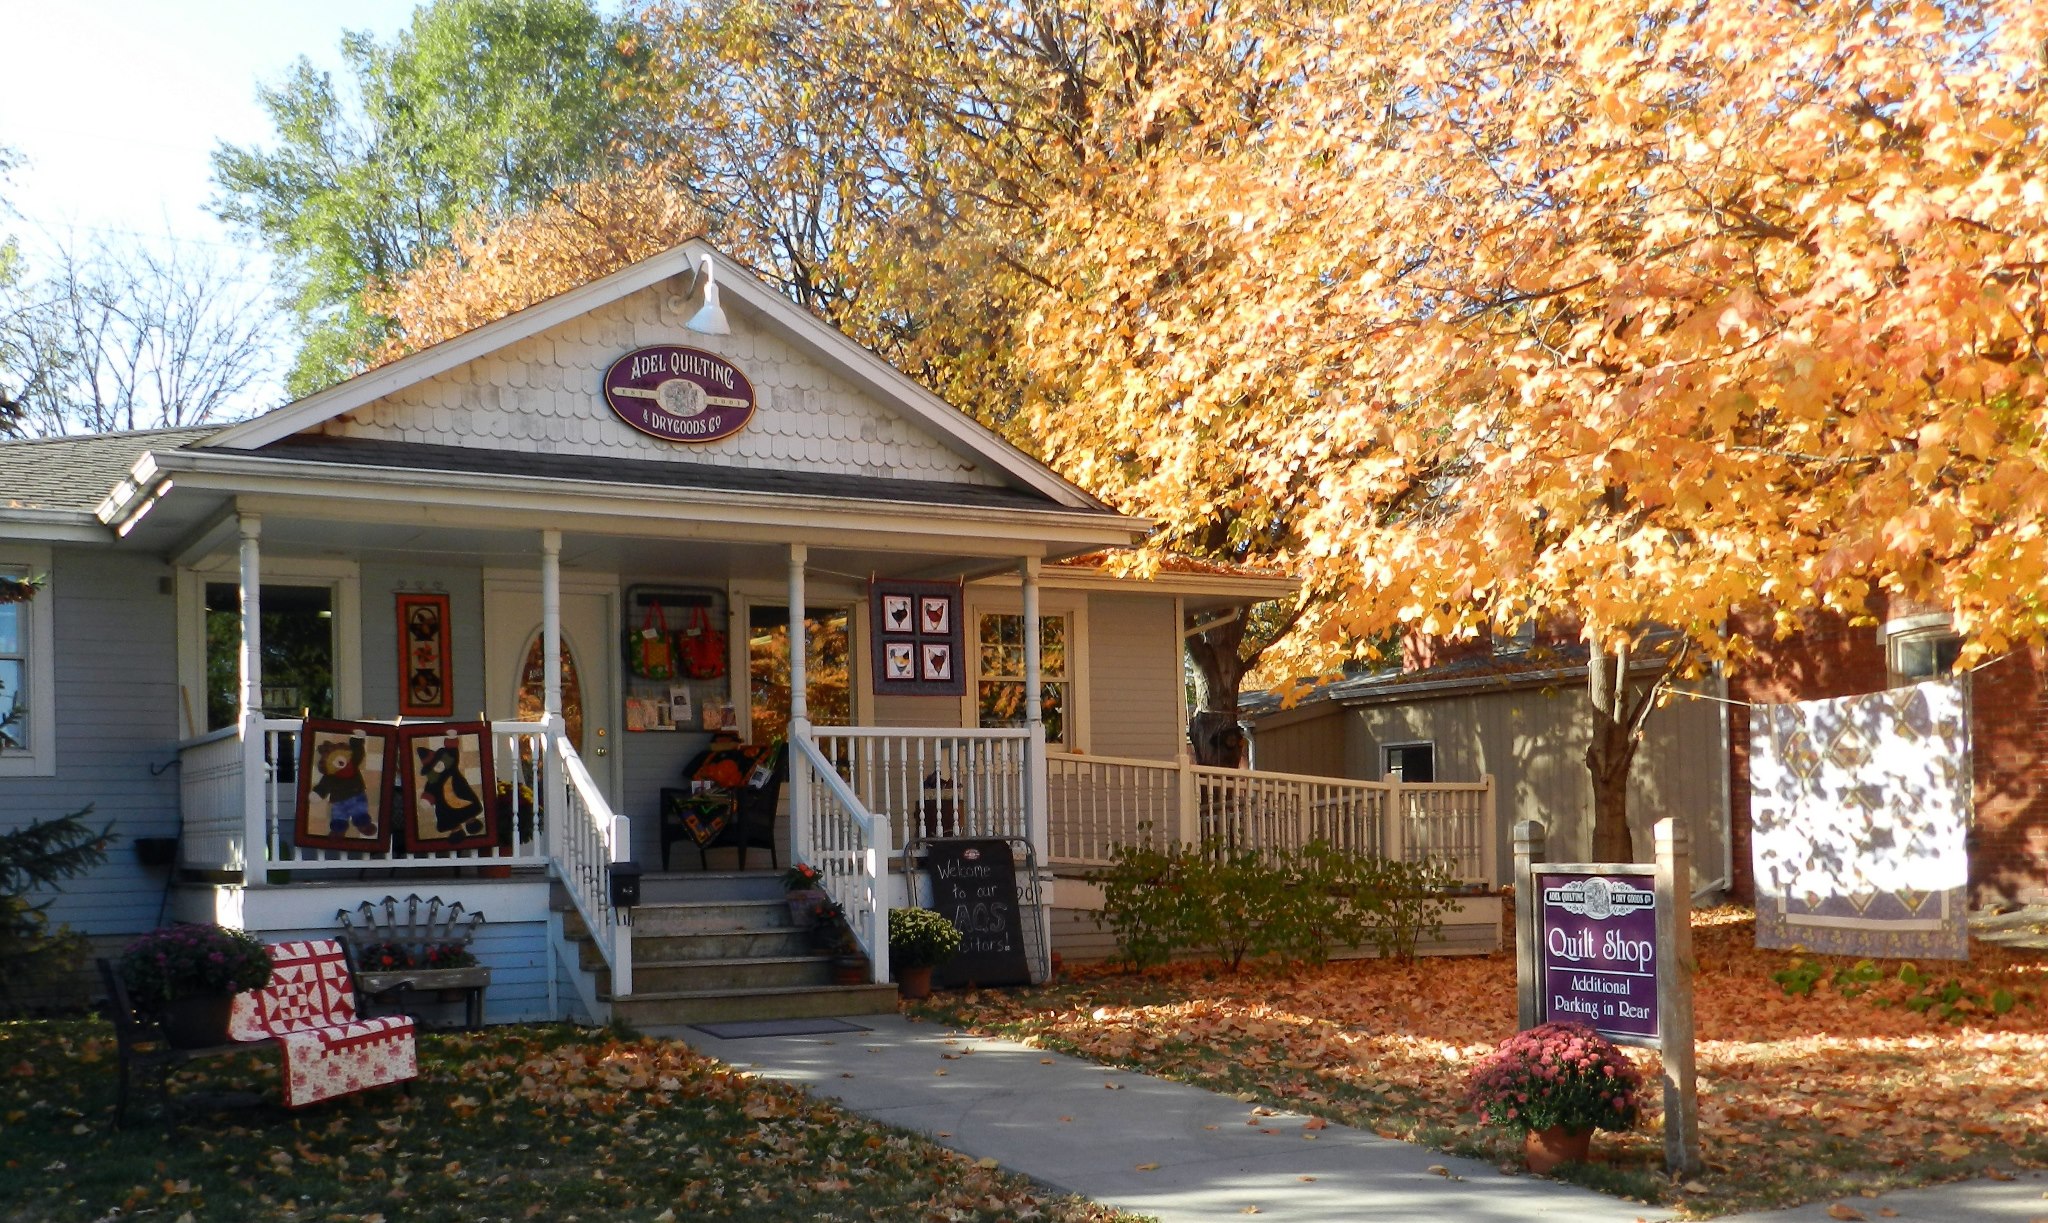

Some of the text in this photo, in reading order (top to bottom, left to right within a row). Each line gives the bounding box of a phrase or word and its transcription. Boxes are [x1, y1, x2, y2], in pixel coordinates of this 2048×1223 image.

[631, 352, 734, 390] ADEL QUILTING
[643, 409, 648, 423] &
[652, 412, 706, 435] DRYGOODS
[937, 858, 991, 880] Welcome
[952, 883, 998, 899] to our
[958, 931, 1011, 953] isitors!
[1549, 927, 1653, 972] Quilt Shop
[1571, 975, 1630, 995] Additional
[1554, 995, 1650, 1020] Parking in Rear
